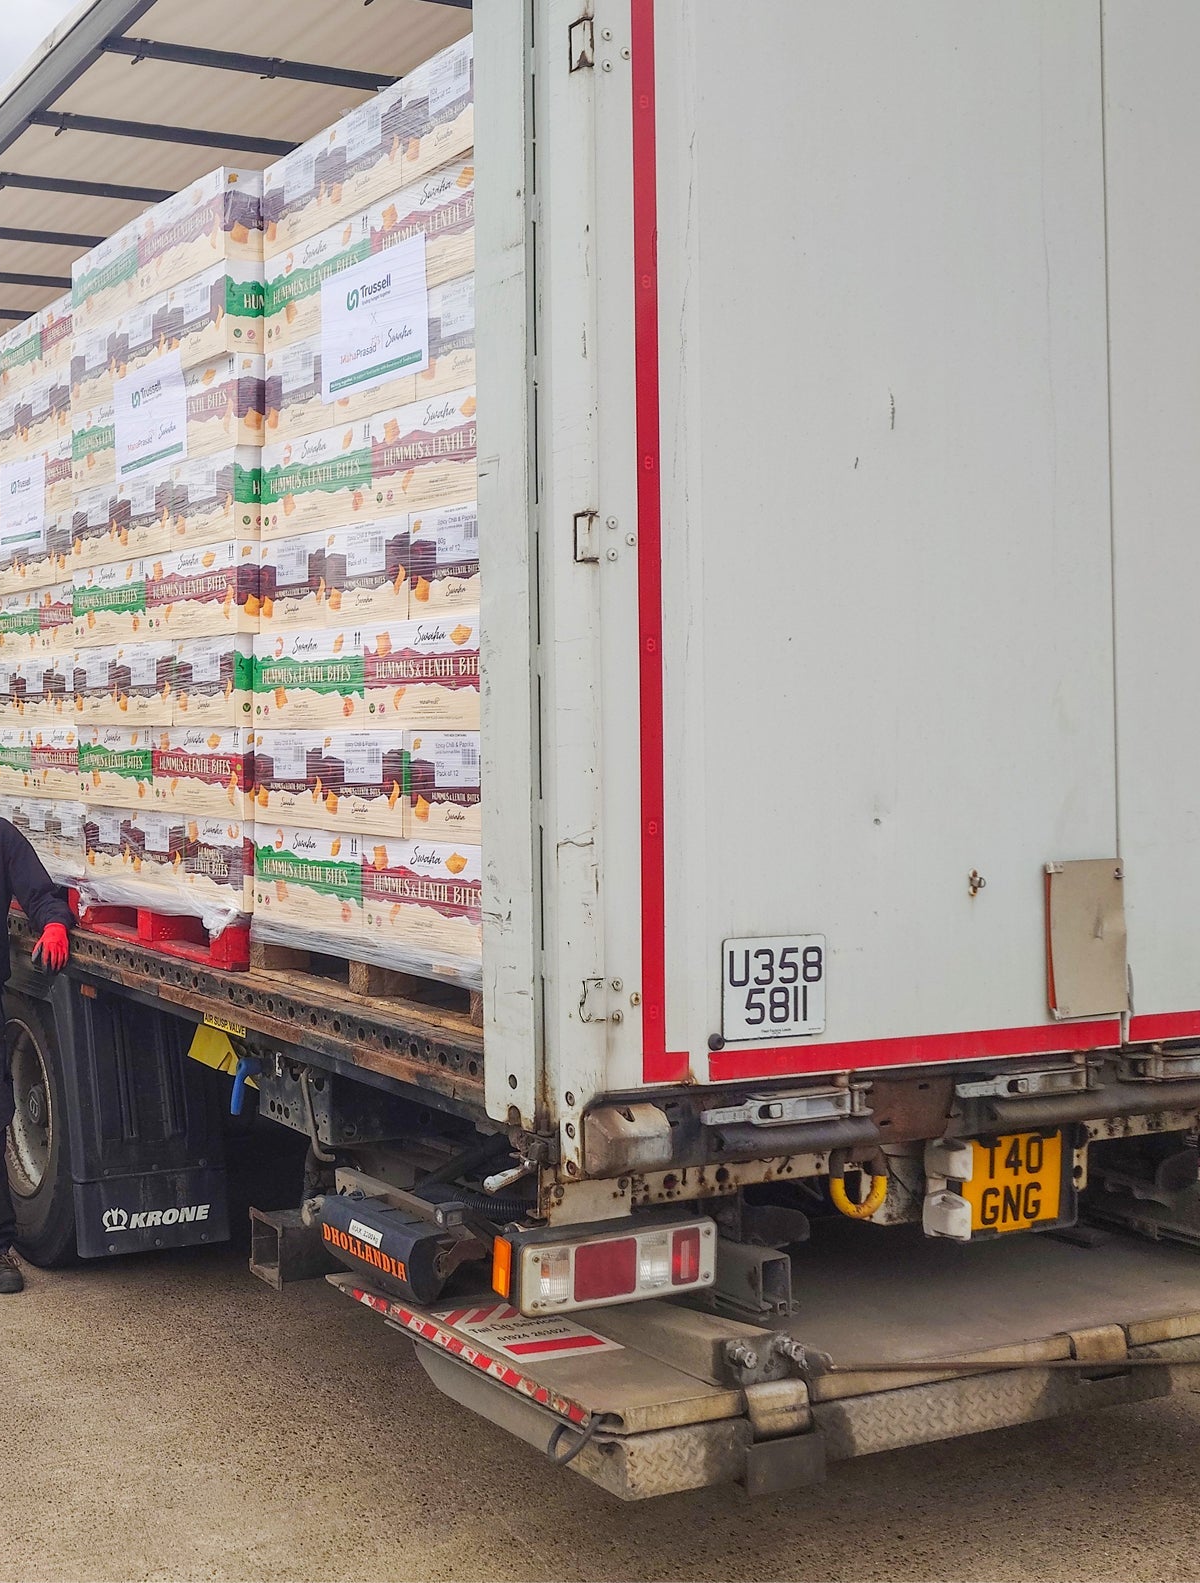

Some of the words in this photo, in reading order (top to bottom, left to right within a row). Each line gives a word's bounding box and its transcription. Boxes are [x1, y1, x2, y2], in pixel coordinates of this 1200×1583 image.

[420, 177, 453, 205] Swaha
[430, 202, 461, 229] LENTIL
[302, 240, 327, 264] Swaha
[273, 278, 304, 305] HUMMUS
[309, 266, 333, 291] LENTIL
[360, 274, 391, 296] Trussell
[386, 325, 413, 348] Swaha
[423, 402, 456, 425] Swaha
[302, 439, 327, 459] Swaha
[384, 442, 423, 466] HUMMUS
[432, 432, 463, 454] LENTIL
[270, 474, 302, 494] HUMMUS
[308, 465, 333, 484] LENTIL
[337, 459, 360, 476] BITES
[178, 553, 199, 570] Swaha
[184, 579, 206, 595] LENTIL
[207, 575, 227, 591] BITES
[446, 584, 467, 596] Swaha
[292, 636, 318, 655] Swaha
[414, 625, 446, 646] Swaha
[262, 668, 292, 684] HUMMUS
[299, 666, 324, 683] LENTIL
[327, 664, 351, 681] BITES
[376, 661, 415, 679] HUMMUS
[423, 658, 456, 677] LENTIL
[459, 656, 480, 675] BIT
[104, 730, 121, 743] Swaha
[184, 730, 204, 746] Swaha
[108, 755, 125, 769] LENTIL
[127, 755, 143, 769] BITES
[159, 755, 183, 772] HUMMUS
[189, 758, 209, 773] LENTIL
[211, 759, 230, 775] BITES
[281, 797, 295, 807] Swaha
[352, 802, 369, 814] Swaha
[467, 793, 479, 802] BITES
[445, 809, 465, 821] Swaha
[203, 821, 223, 835] Swaha
[293, 832, 317, 850] Swaha
[410, 846, 442, 865] Swaha
[263, 859, 293, 878] HUMMUS
[299, 864, 322, 883] LENTIL
[326, 867, 348, 886] BITES
[374, 874, 409, 896] HUMMUS
[418, 882, 448, 902] LENTIL
[453, 887, 482, 908] BITES
[729, 946, 822, 987] U358
[745, 985, 807, 1025] 5811
[228, 1022, 245, 1035] VALVE
[981, 1136, 1043, 1179] T40
[981, 1182, 1041, 1225] GNG
[130, 1205, 210, 1229] KRONE
[323, 1222, 407, 1282] DHOLLANDIA
